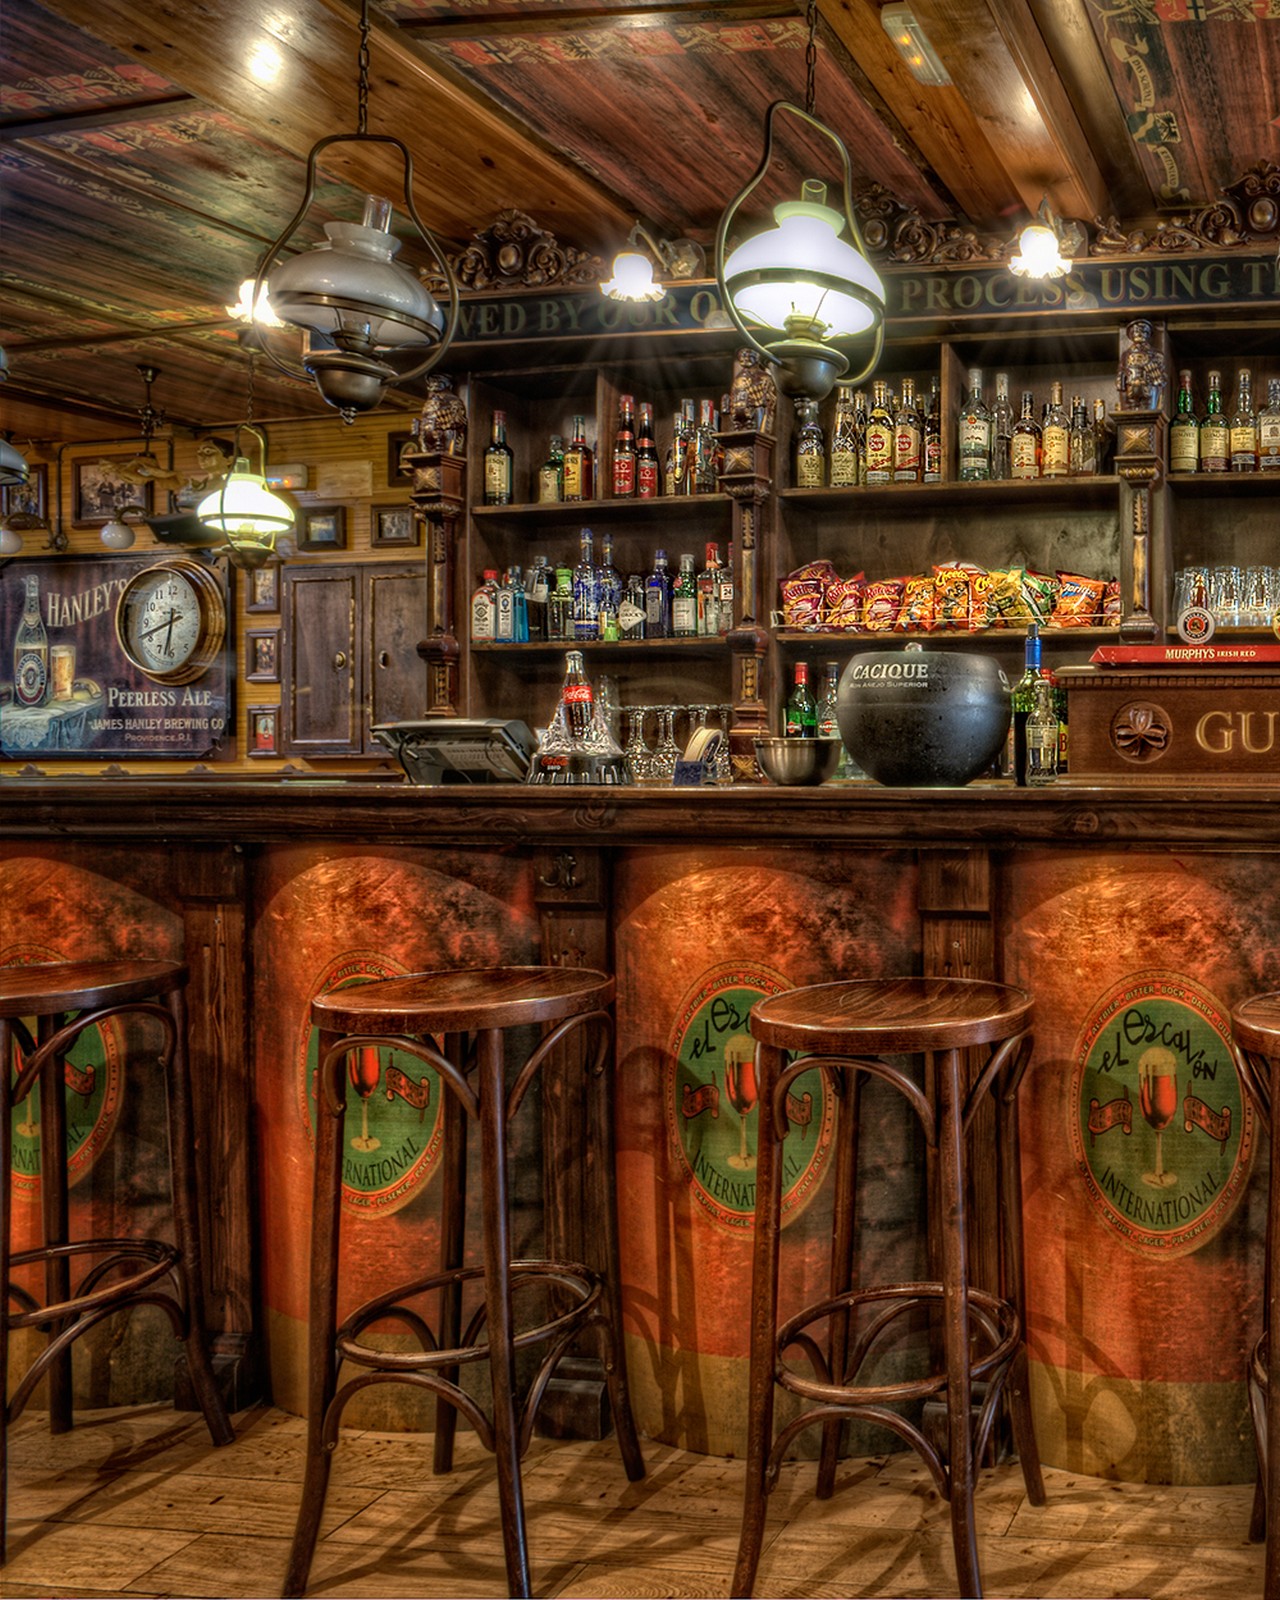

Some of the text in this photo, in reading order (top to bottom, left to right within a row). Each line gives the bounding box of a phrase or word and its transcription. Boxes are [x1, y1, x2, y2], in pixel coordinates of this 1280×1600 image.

[443, 300, 527, 336] WED
[537, 299, 586, 332] BY
[900, 270, 1087, 311] PROCESS
[1100, 263, 1233, 302] USING
[853, 663, 929, 680] CACIQUE
[108, 685, 212, 707] PEERLESS ALE
[91, 718, 124, 730] JAMES
[125, 718, 162, 730] HANLEY
[164, 718, 208, 730] BREWING
[712, 975, 739, 991] BITTER
[744, 976, 767, 988] BOCK
[1125, 985, 1155, 1002] BITTER
[1161, 985, 1185, 999] BOCK
[1190, 996, 1214, 1018] DARK
[344, 1137, 420, 1187] RNATIONAL
[692, 1150, 802, 1207] INTERNATAL
[1100, 1165, 1221, 1226] INTERNATIONAL
[1137, 1233, 1166, 1247] LAGER
[1172, 1218, 1212, 1244] PILSENER
